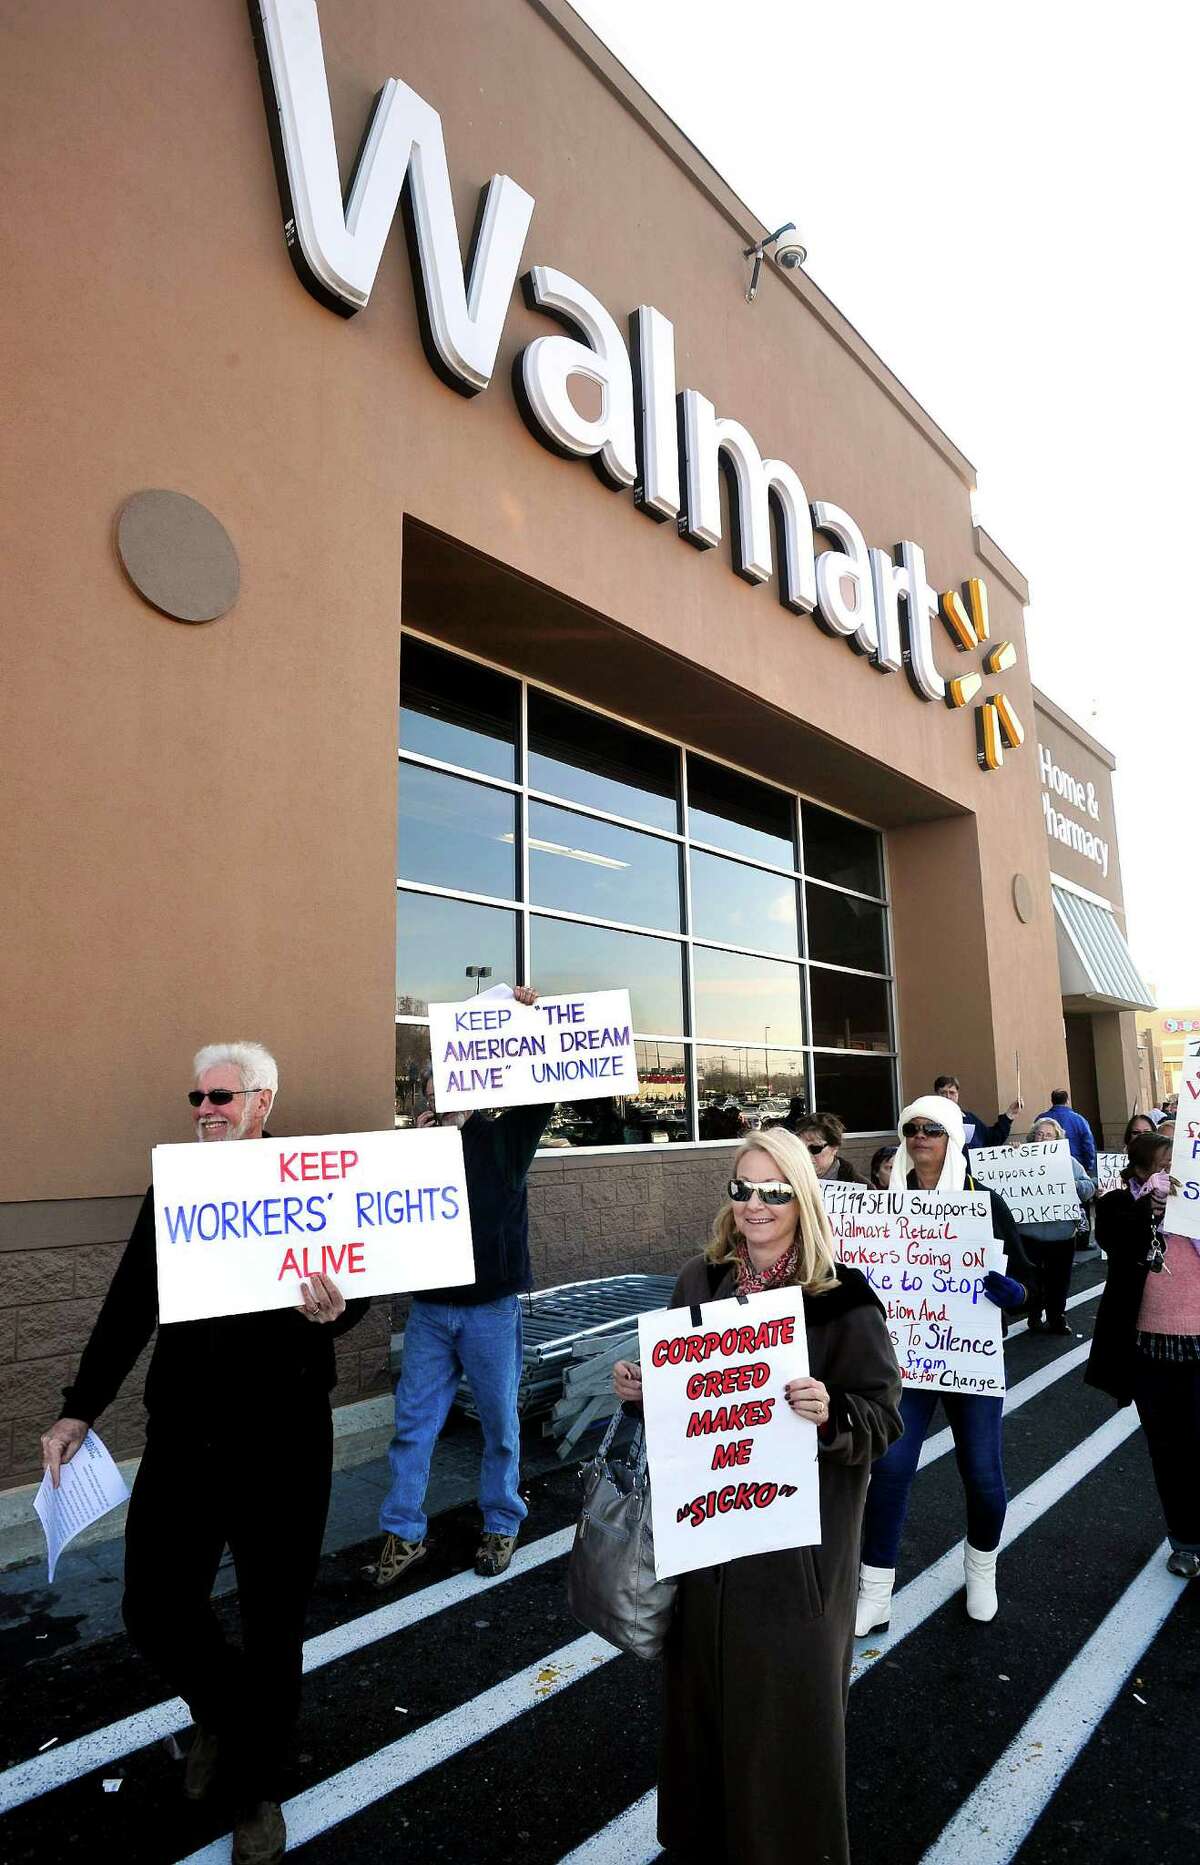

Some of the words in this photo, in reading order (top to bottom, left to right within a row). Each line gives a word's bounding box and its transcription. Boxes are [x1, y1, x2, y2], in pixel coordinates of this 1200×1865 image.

[251, 0, 947, 701] Walmart
[1038, 743, 1086, 812] Home
[1086, 782, 1100, 821] &
[455, 1009, 512, 1032] KEEP
[443, 1035, 546, 1063] AMERICAN
[560, 1026, 630, 1052] DREAM
[531, 1055, 624, 1084] UNIONIZE
[278, 1150, 359, 1183] KEEP
[977, 1149, 1014, 1162] 1199
[1019, 1143, 1058, 1158] SEIU
[999, 1182, 1067, 1198] ALMART
[164, 1192, 334, 1244] WORKERS'
[356, 1185, 459, 1228] RIGHTS
[910, 1196, 988, 1221] Supports
[1010, 1203, 1081, 1223] ORKERS
[277, 1242, 366, 1281] ALIVE
[907, 1241, 951, 1274] Going
[900, 1271, 923, 1291] to
[932, 1269, 985, 1304] Stop
[918, 1298, 949, 1321] And
[652, 1316, 795, 1368] CORPORATE
[904, 1324, 921, 1346] To
[925, 1323, 997, 1356] Silence
[906, 1350, 947, 1370] from
[686, 1362, 771, 1400] GREED
[918, 1369, 938, 1383] for
[939, 1370, 1005, 1391] Change.
[686, 1398, 776, 1438] MAKES
[711, 1439, 753, 1470] ME
